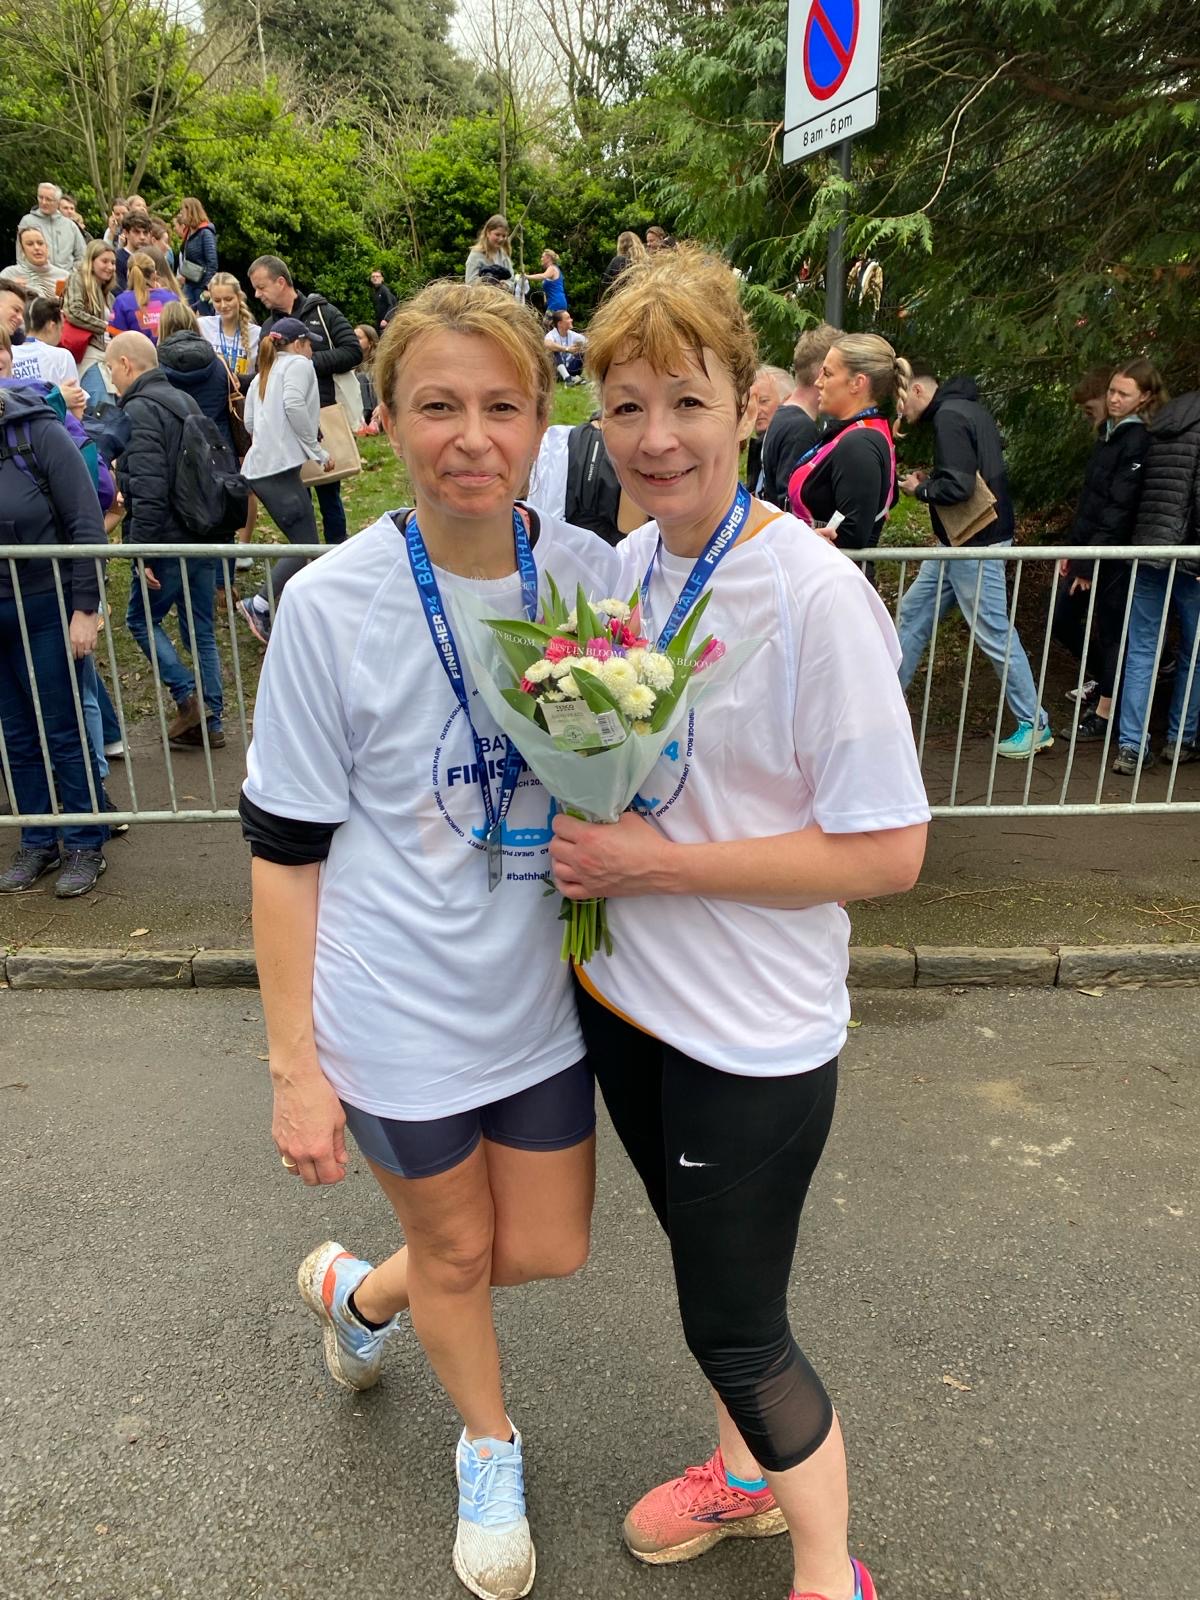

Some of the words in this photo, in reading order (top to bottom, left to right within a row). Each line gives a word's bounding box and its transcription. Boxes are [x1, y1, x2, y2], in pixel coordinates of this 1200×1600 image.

[407, 518, 434, 586] BATHA
[504, 632, 535, 647] BLOOM
[585, 647, 623, 658] BLOOM
[677, 657, 713, 671] BLOOM
[440, 719, 453, 741] QUEEN
[686, 737, 694, 757] ROAD
[433, 746, 442, 764] PARK
[656, 804, 669, 817] ROAD
[506, 870, 551, 881] #bathhalf
